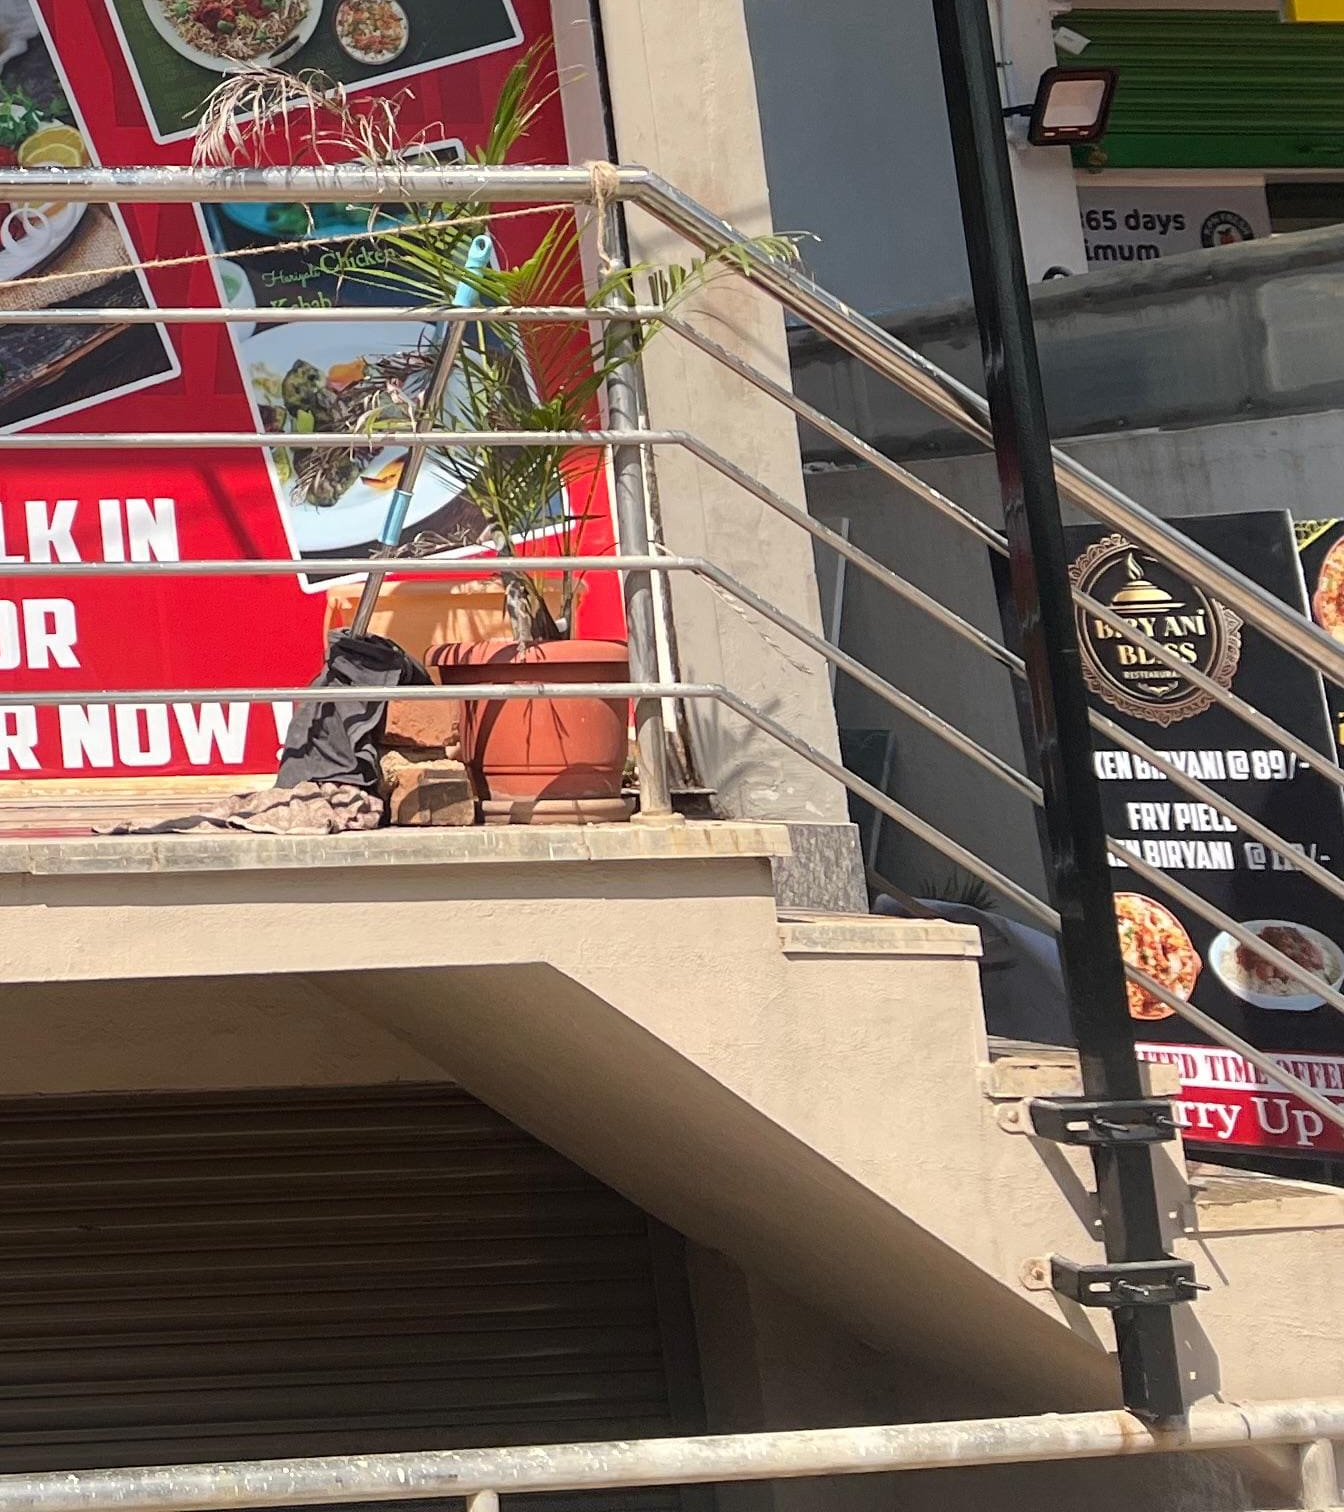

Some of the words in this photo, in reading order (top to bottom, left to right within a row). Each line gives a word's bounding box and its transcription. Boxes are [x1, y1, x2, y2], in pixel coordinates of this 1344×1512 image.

[1124, 208, 1185, 235] days
[98, 498, 180, 563] IN
[58, 701, 251, 769] NOW
[1126, 802, 1172, 831] FRY
[1142, 841, 1236, 870] BIRYANI
[1250, 1097, 1324, 1147] Up
